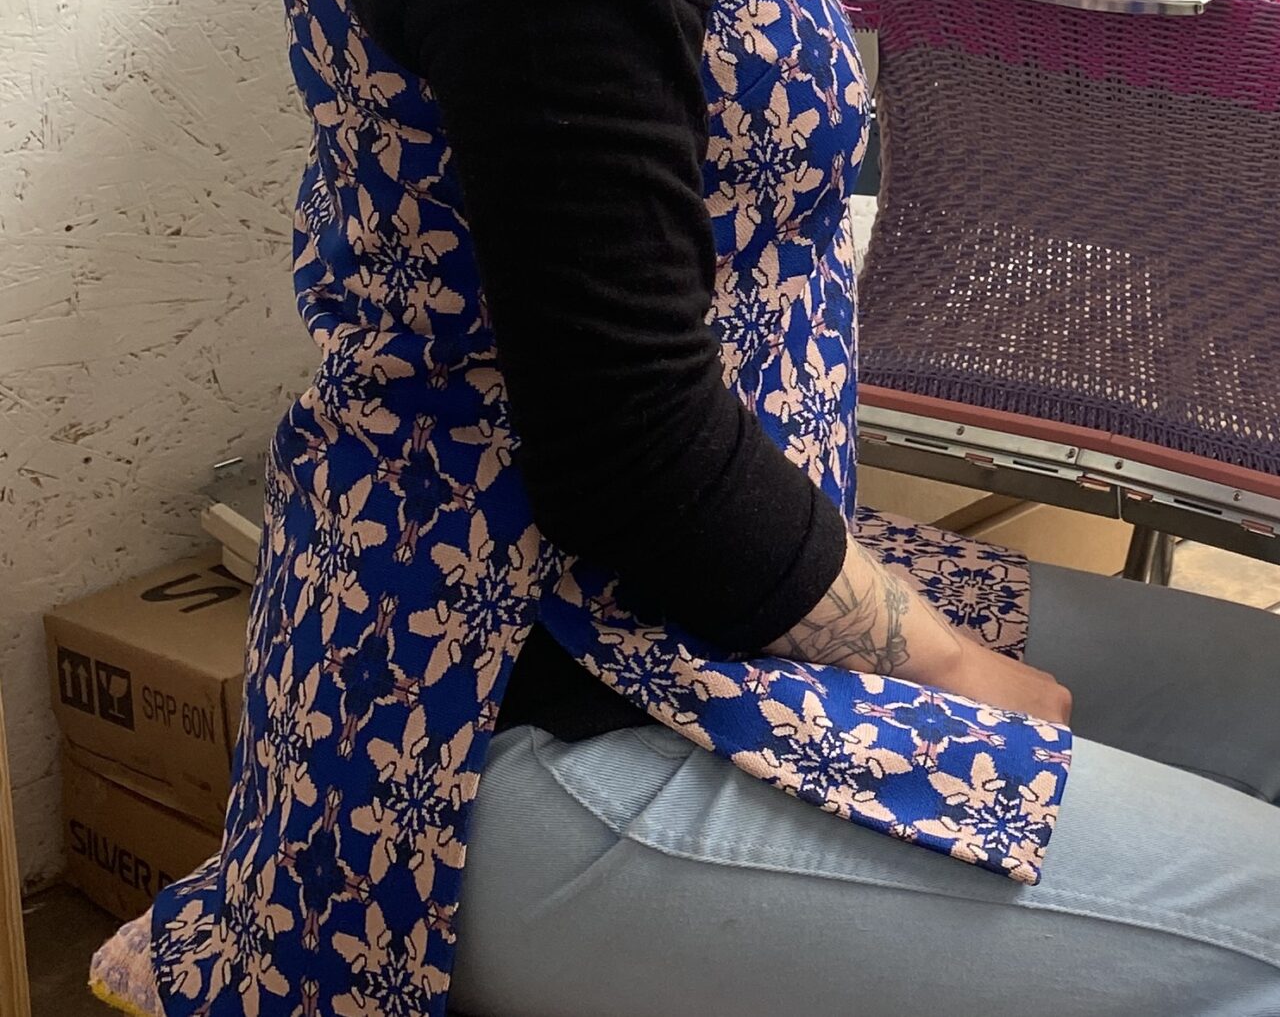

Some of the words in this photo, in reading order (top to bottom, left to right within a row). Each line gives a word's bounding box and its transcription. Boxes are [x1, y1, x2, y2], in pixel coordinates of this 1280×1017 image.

[142, 685, 177, 727] SRP
[182, 702, 215, 744] 60N
[69, 818, 154, 898] SILVER
